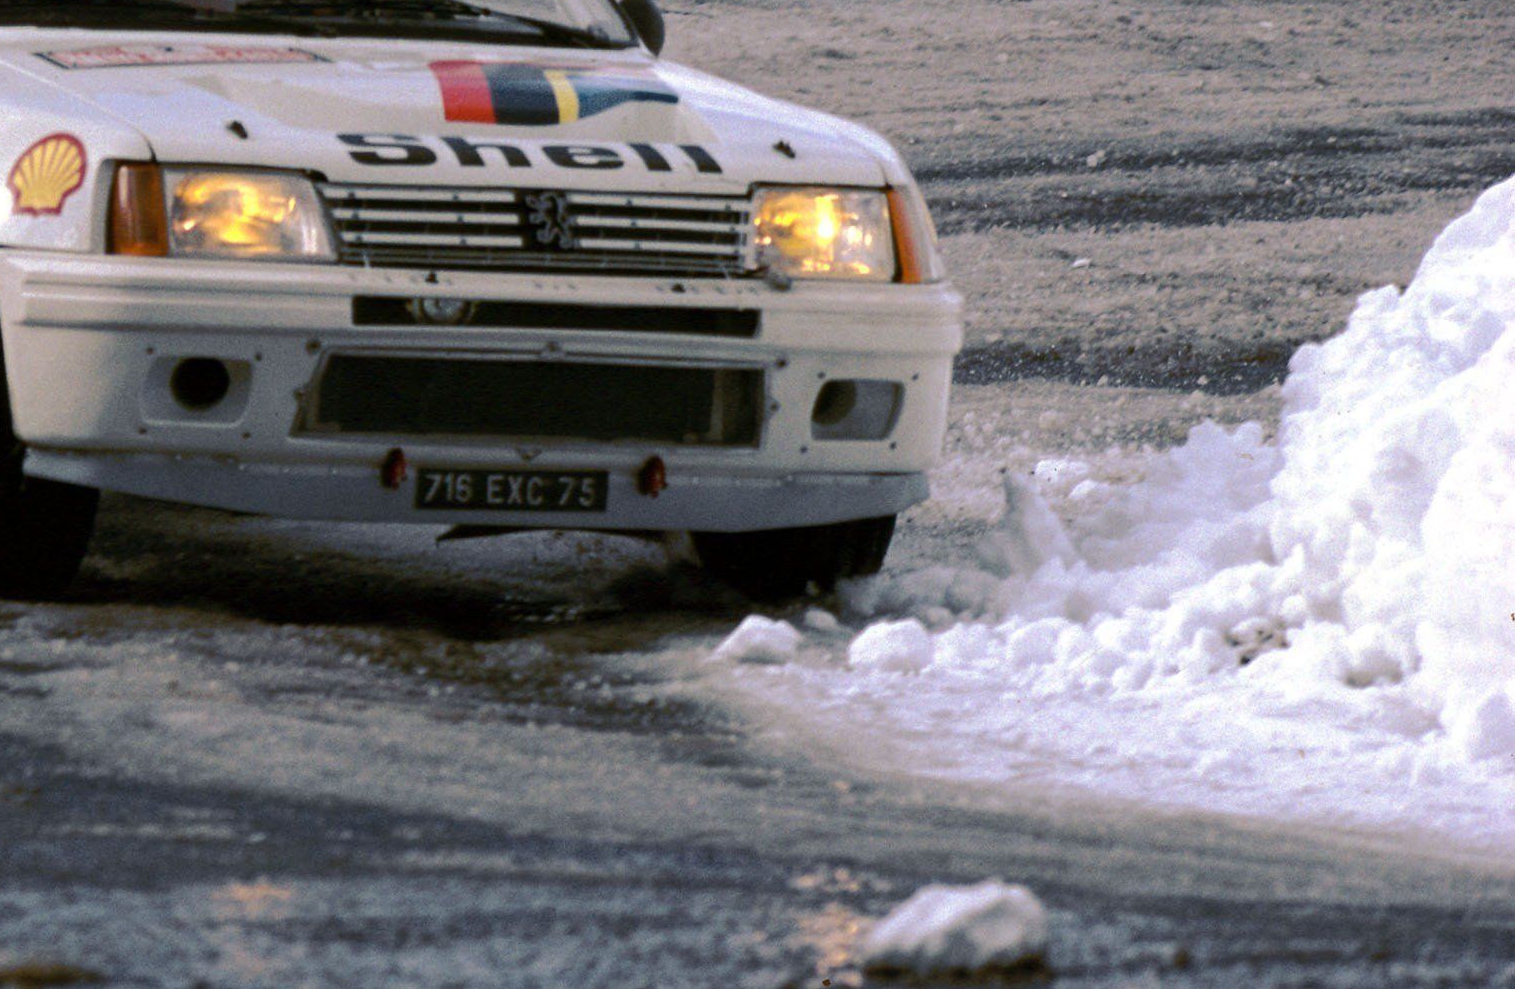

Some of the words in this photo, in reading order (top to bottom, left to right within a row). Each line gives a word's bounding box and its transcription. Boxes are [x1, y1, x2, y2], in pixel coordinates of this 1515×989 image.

[335, 133, 724, 174] Shell
[424, 472, 472, 503] 716
[486, 474, 543, 505] EXC
[557, 476, 597, 507] 75
